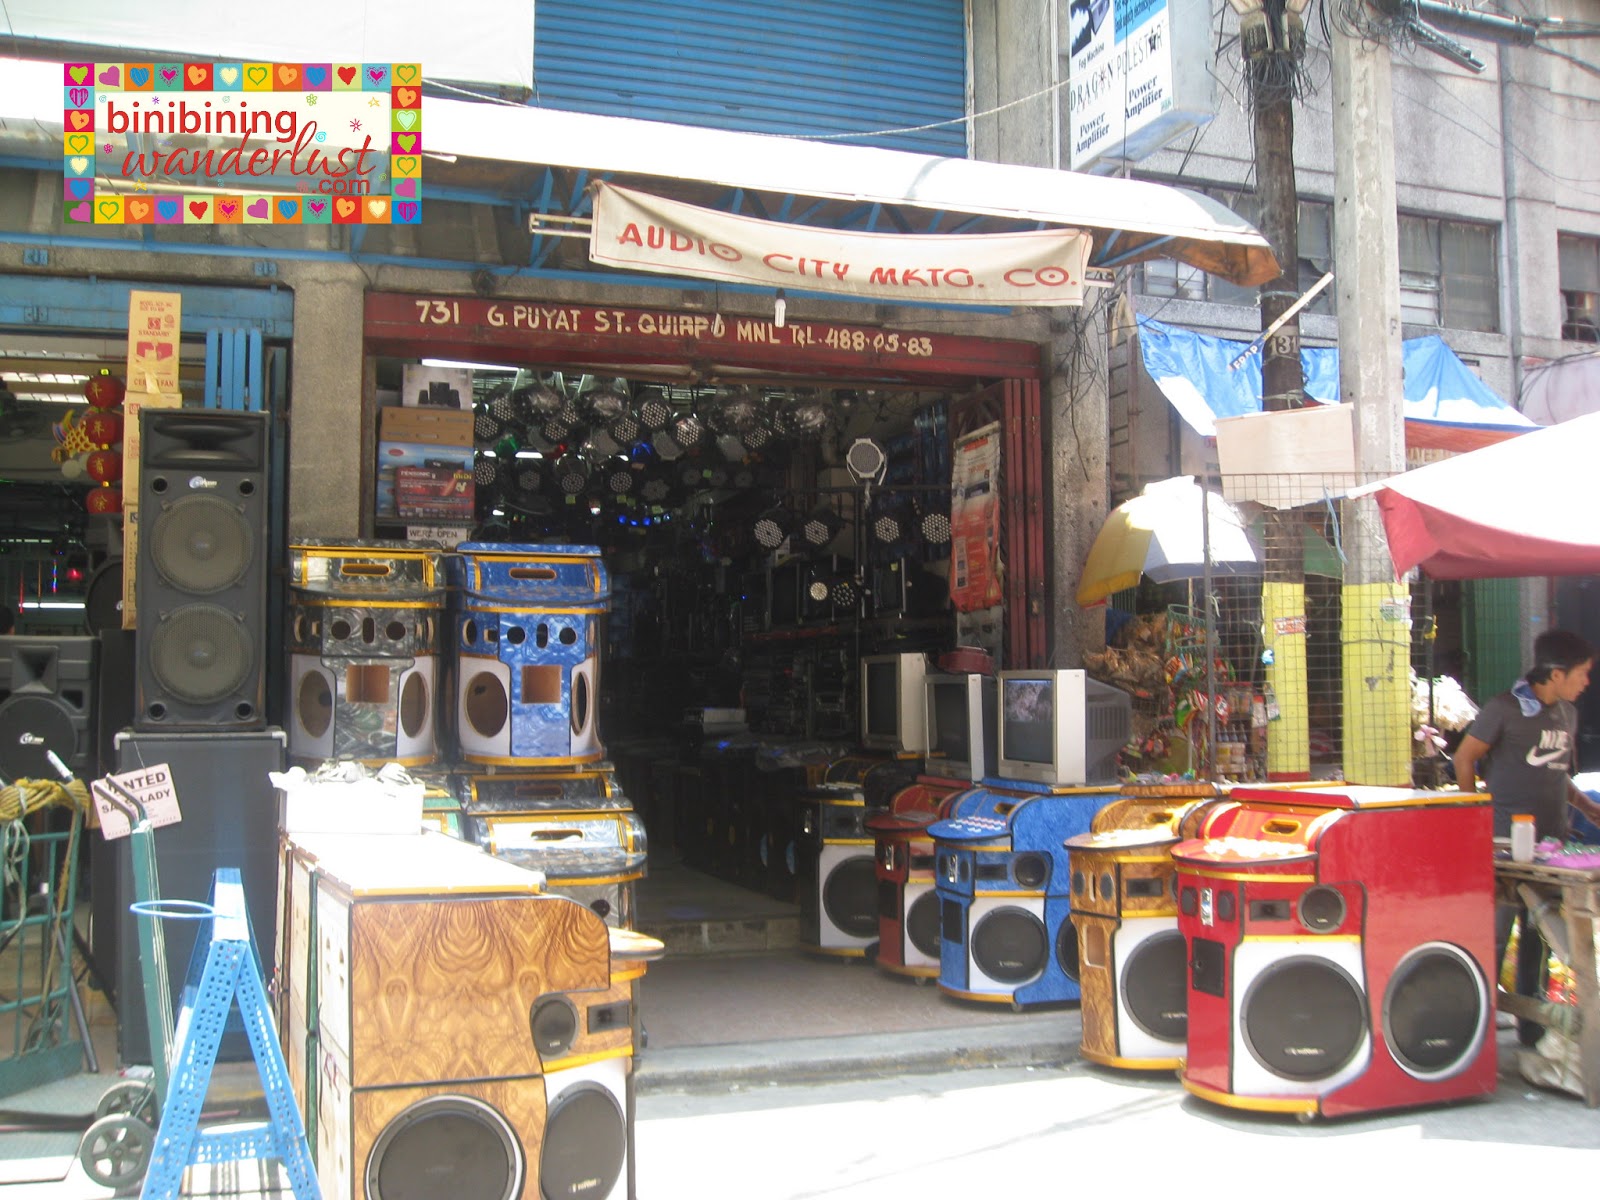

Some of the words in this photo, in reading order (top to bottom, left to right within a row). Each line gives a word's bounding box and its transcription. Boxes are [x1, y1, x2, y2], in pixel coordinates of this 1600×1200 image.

[1128, 75, 1158, 103] Power
[1124, 88, 1163, 120] Amplifier
[1075, 124, 1110, 154] Amplifier
[1079, 111, 1106, 138] Power
[616, 222, 743, 263] AUDIO
[762, 253, 850, 281] CITY
[869, 267, 985, 289] MKTG.
[1003, 266, 1077, 288] CO.
[415, 300, 459, 325] 731
[513, 305, 581, 331] PUYAT
[594, 310, 631, 334] ST.
[737, 320, 781, 344] MNL
[1270, 335, 1299, 356] 131
[106, 771, 167, 796] NTED
